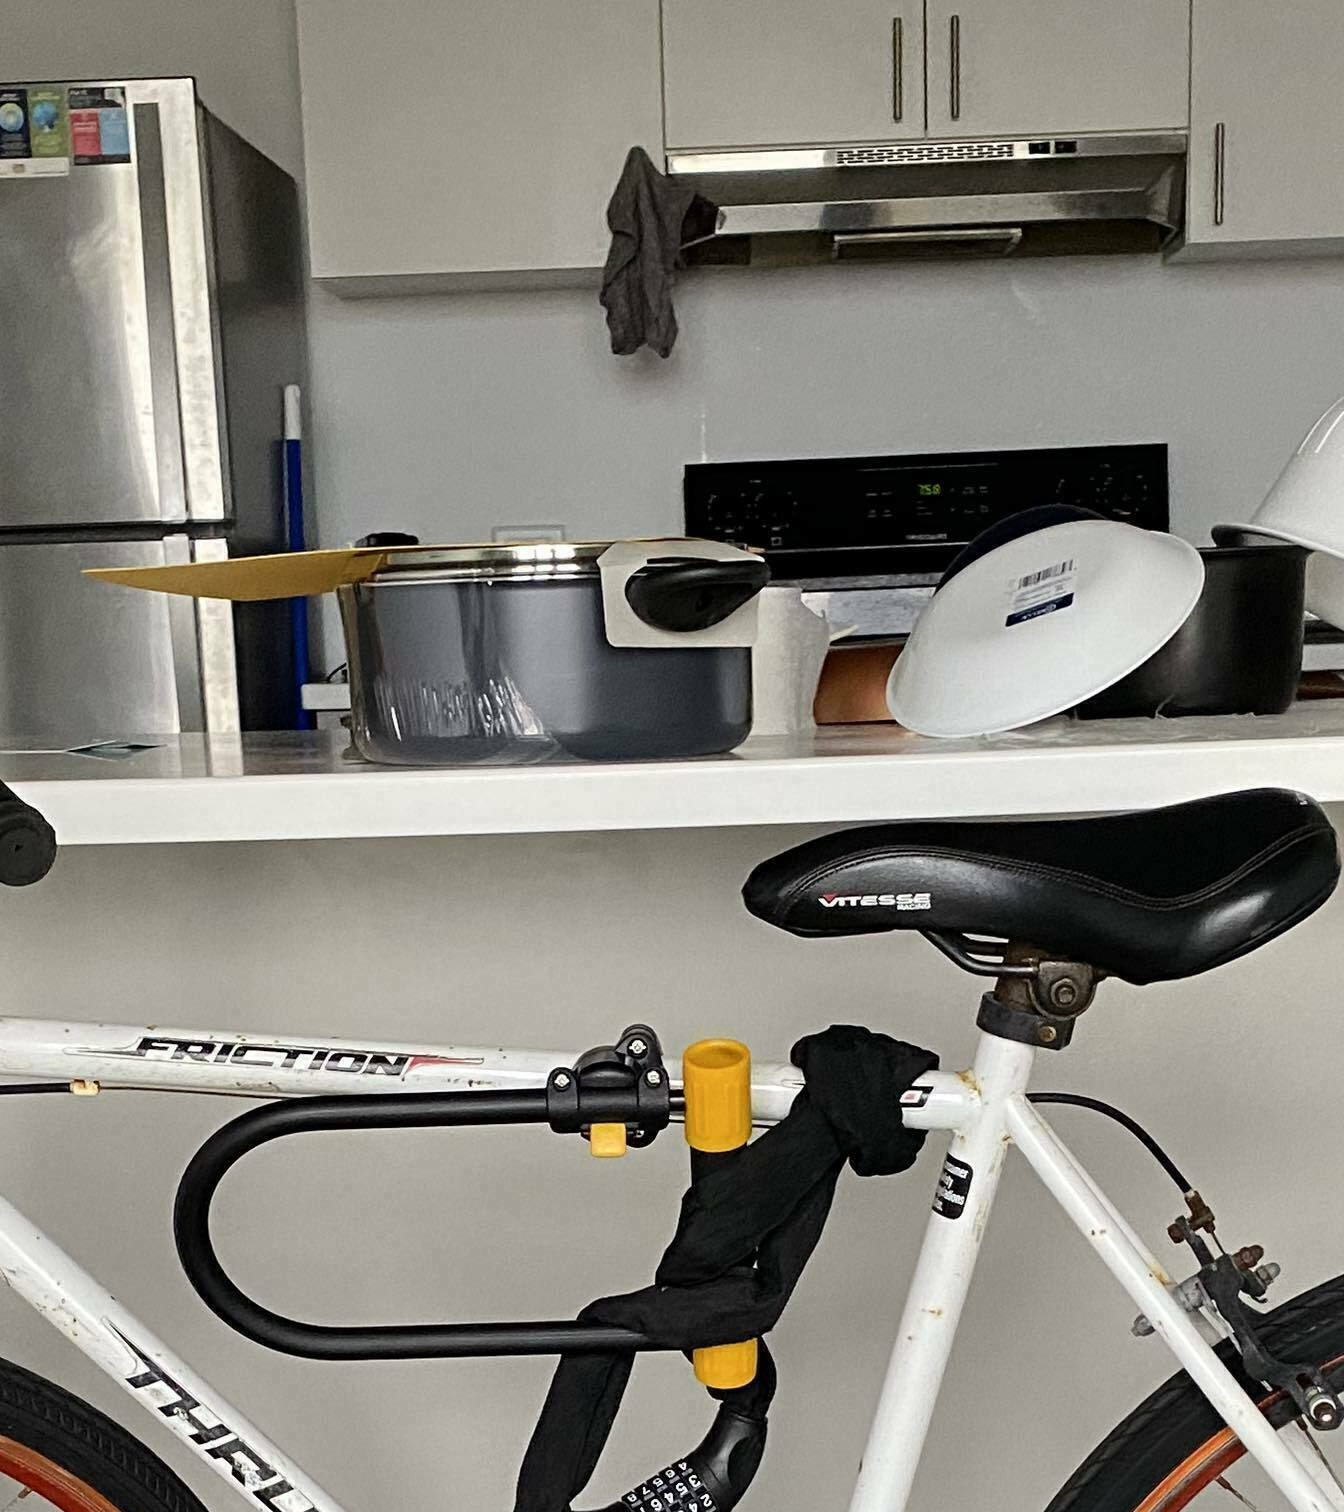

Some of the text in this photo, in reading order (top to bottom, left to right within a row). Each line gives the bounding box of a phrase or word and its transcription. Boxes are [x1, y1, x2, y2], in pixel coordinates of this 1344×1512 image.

[818, 893, 932, 908] VITESSE
[132, 1037, 409, 1076] FRICTION
[688, 1474, 701, 1488] 3
[675, 1482, 689, 1498] 5
[650, 1498, 663, 1512] 6
[664, 1492, 674, 1504] 4
[699, 1493, 713, 1507] 2
